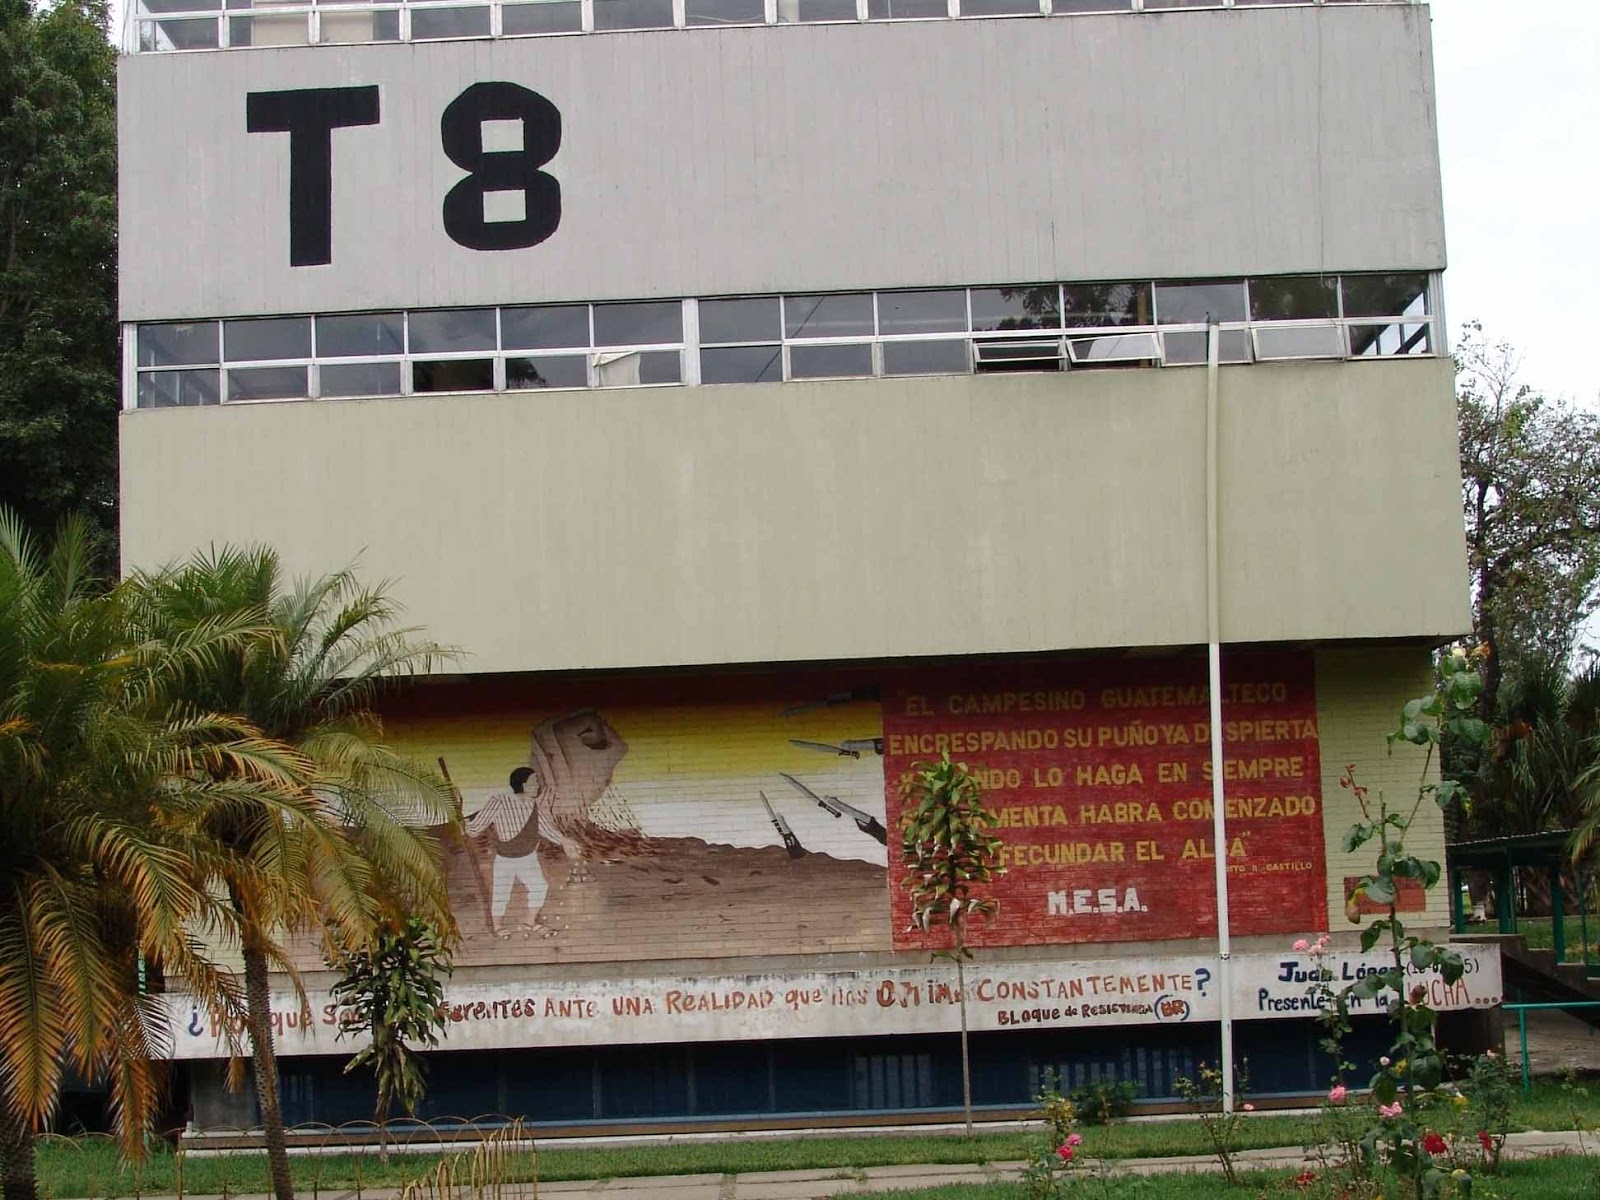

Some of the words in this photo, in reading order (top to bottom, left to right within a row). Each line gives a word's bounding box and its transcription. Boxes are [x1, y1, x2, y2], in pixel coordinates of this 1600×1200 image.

[949, 690, 1086, 716] CAMPESINO
[1103, 683, 1286, 708] GUATEMATECO
[889, 729, 1059, 755] ENCRESPANDO
[1064, 727, 1092, 748] SU
[1098, 720, 1159, 747] PUÑO
[1160, 723, 1189, 744] YA
[1194, 718, 1319, 743] DSPIERTA
[1034, 766, 1064, 788] LO
[1077, 762, 1143, 785] HAGA
[1158, 762, 1188, 783] EN
[1201, 756, 1305, 781] SEMPRE
[1080, 800, 1162, 824] HABRA
[1000, 840, 1126, 866] FECUNDAR
[1136, 839, 1164, 860] EL
[1224, 864, 1246, 873] TTO
[1266, 861, 1313, 872] CASTILLO
[1047, 887, 1149, 916] M.E.S.A.
[612, 994, 654, 1016] UNA
[785, 988, 822, 1010] que
[1064, 1005, 1078, 1017] de
[1258, 987, 1326, 1012] Presente
